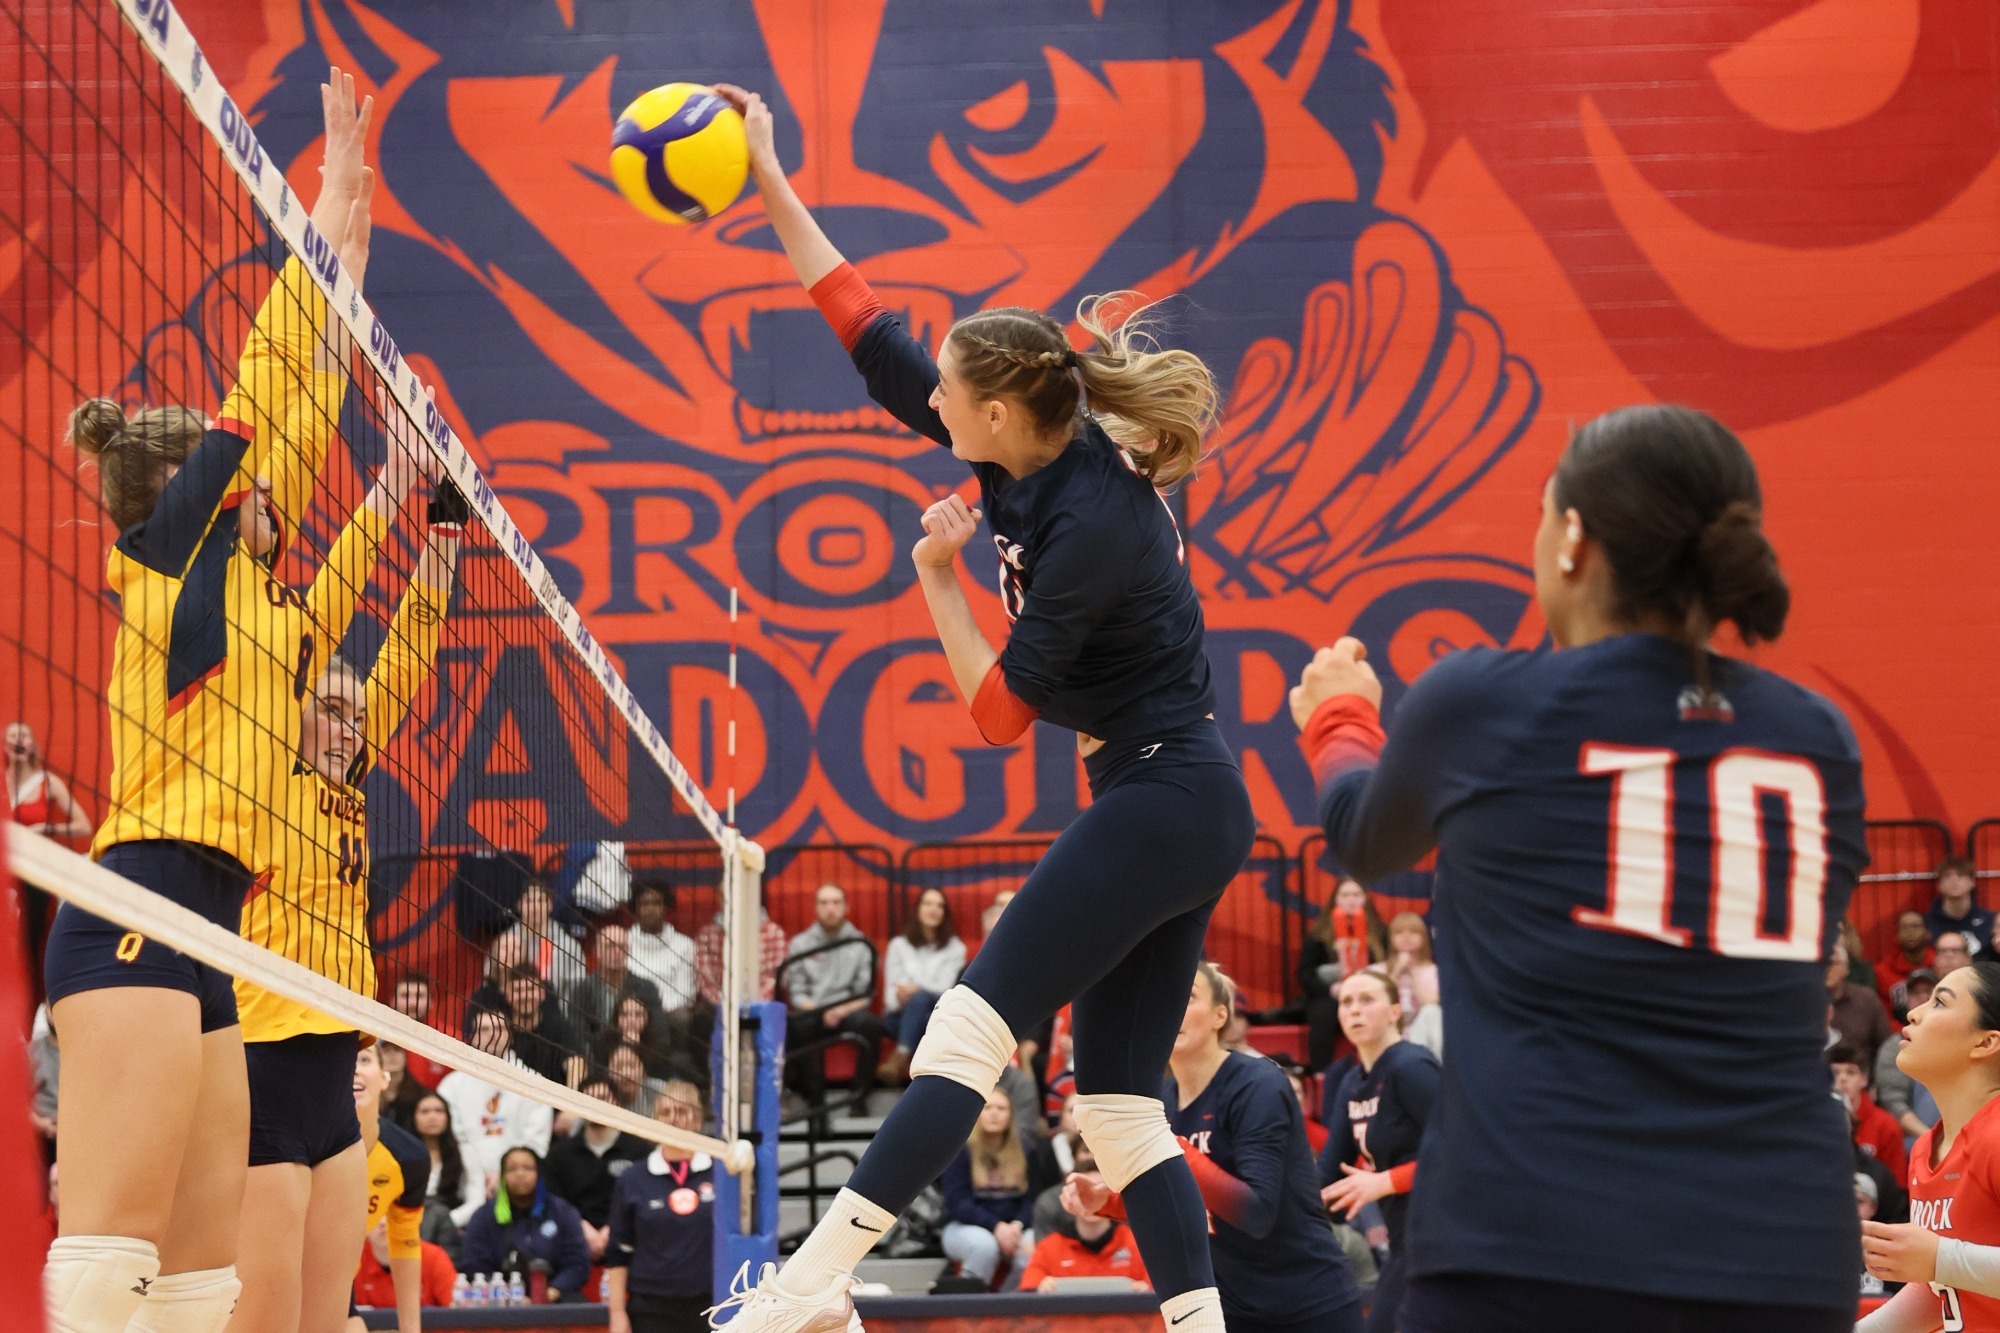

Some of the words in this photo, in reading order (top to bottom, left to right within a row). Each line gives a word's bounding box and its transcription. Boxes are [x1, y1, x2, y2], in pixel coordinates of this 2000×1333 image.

[219, 94, 263, 191] OUA
[303, 217, 339, 295] OUA
[370, 315, 401, 385] OUA
[425, 399, 451, 461] OUA
[473, 468, 495, 525] OUA
[418, 472, 1290, 616] BROK
[513, 529, 534, 574] OUA
[1571, 740, 1831, 963] 10
[115, 929, 146, 965] Q
